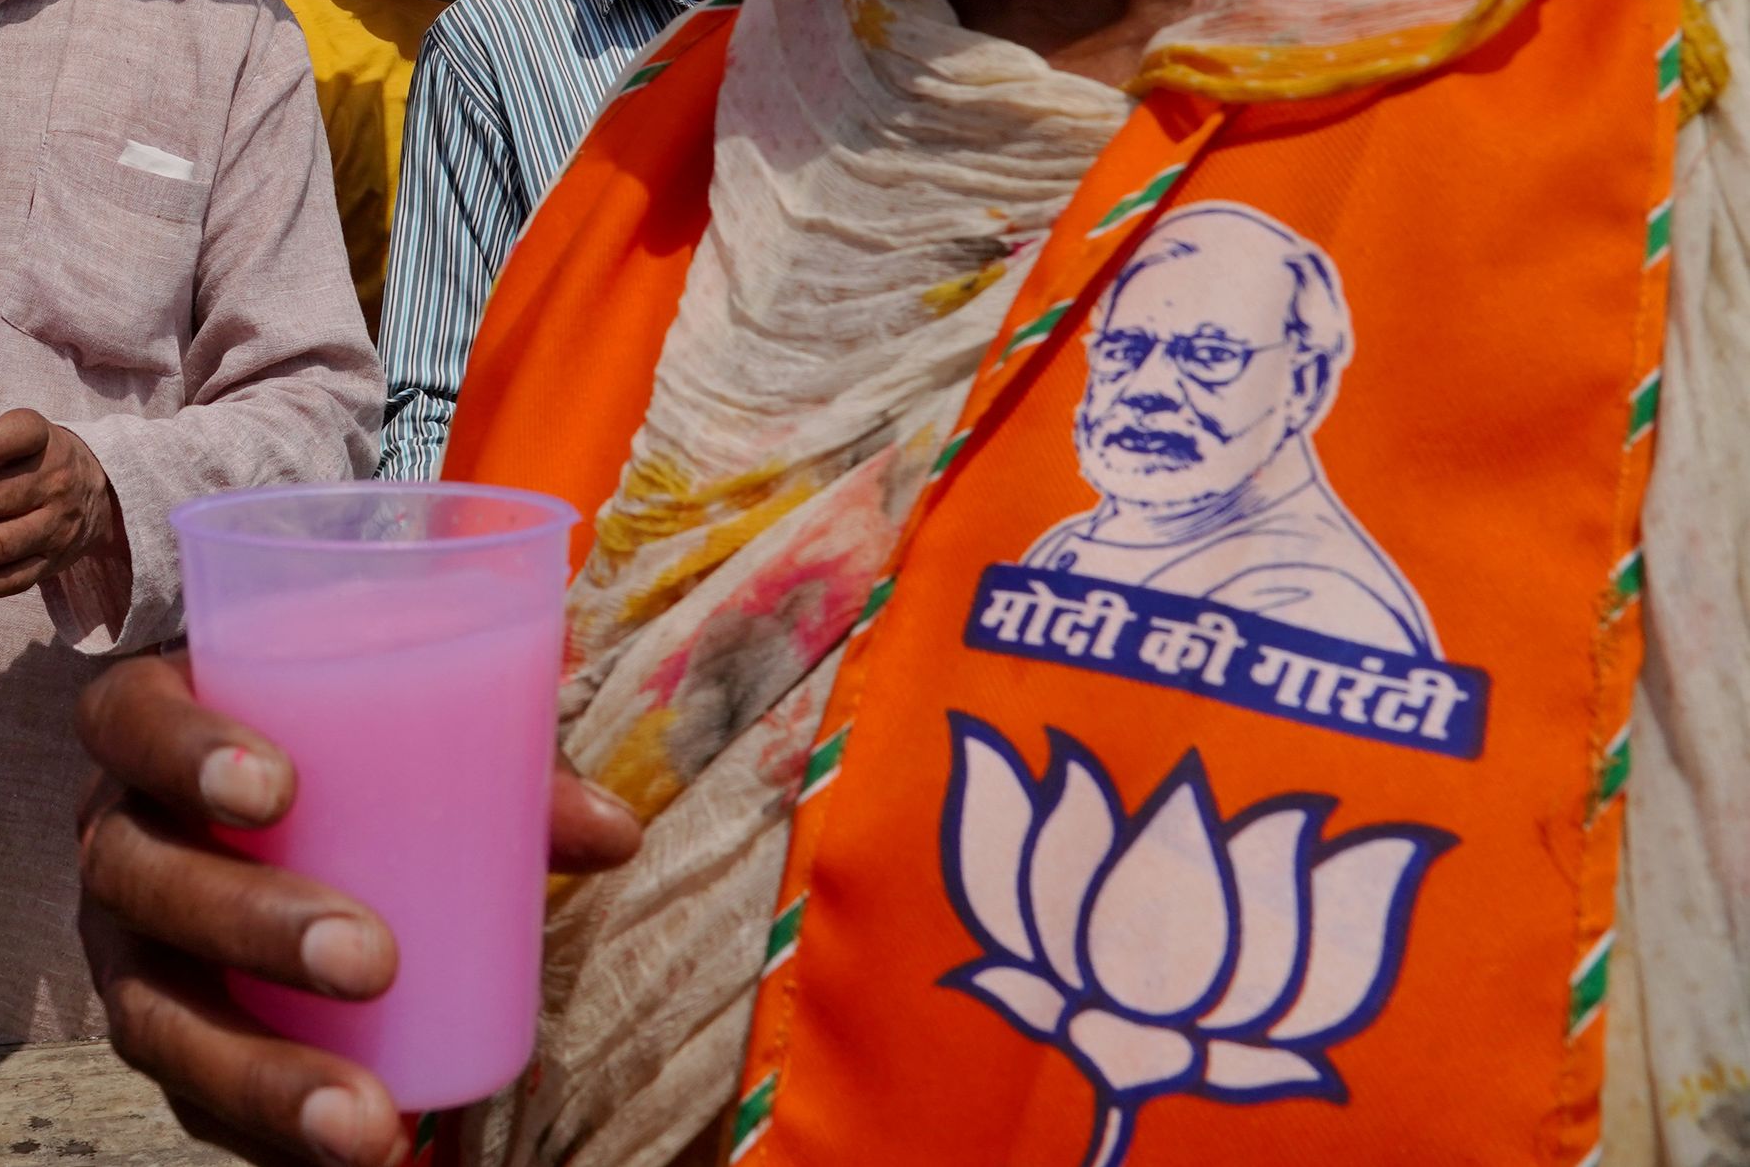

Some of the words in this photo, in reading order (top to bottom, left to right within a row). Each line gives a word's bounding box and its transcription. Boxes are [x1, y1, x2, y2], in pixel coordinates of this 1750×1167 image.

[979, 580, 1137, 660] मोदी
[1138, 611, 1248, 686] की
[1250, 645, 1469, 740] गारंटी
